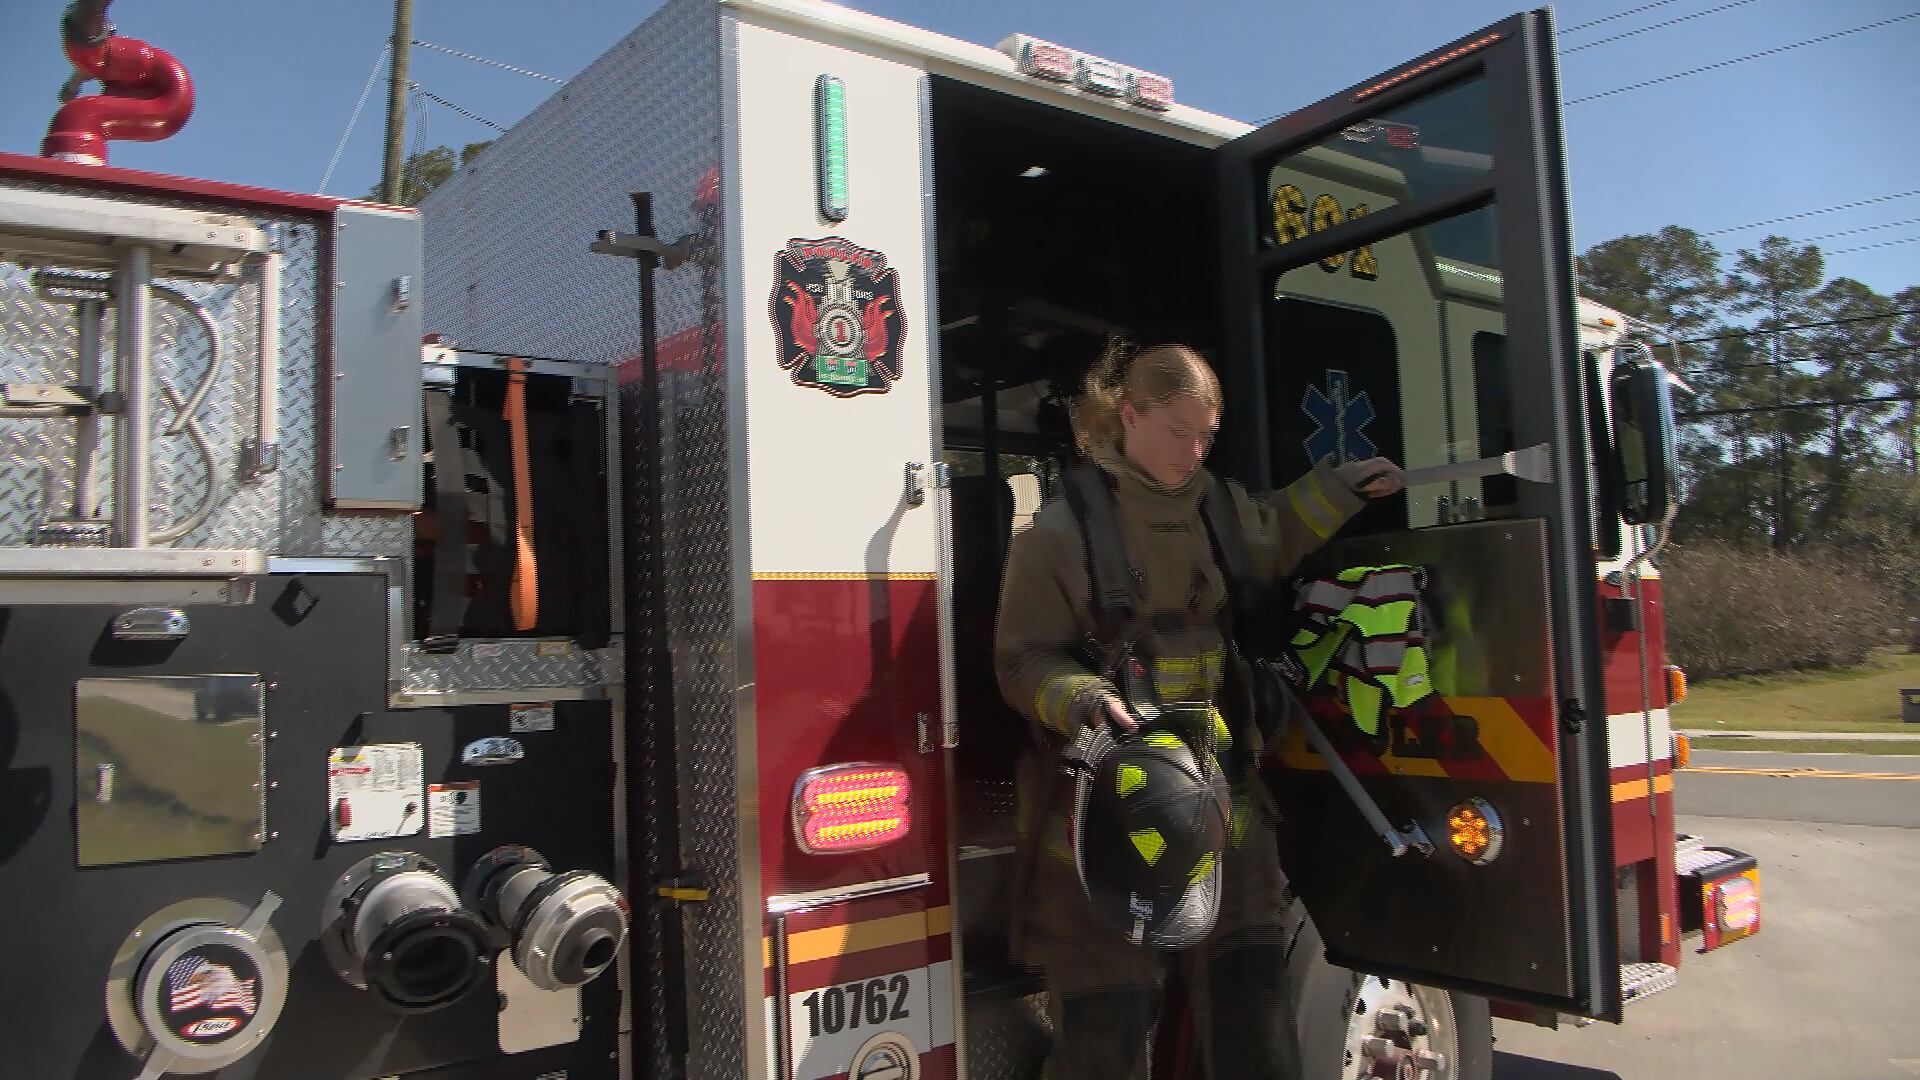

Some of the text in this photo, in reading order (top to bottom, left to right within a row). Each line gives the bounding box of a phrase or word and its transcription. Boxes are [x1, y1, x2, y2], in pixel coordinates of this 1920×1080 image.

[1273, 184, 1379, 281] 601
[801, 247, 873, 268] POOLER
[834, 321, 847, 343] 1
[802, 974, 910, 1037] 10762
